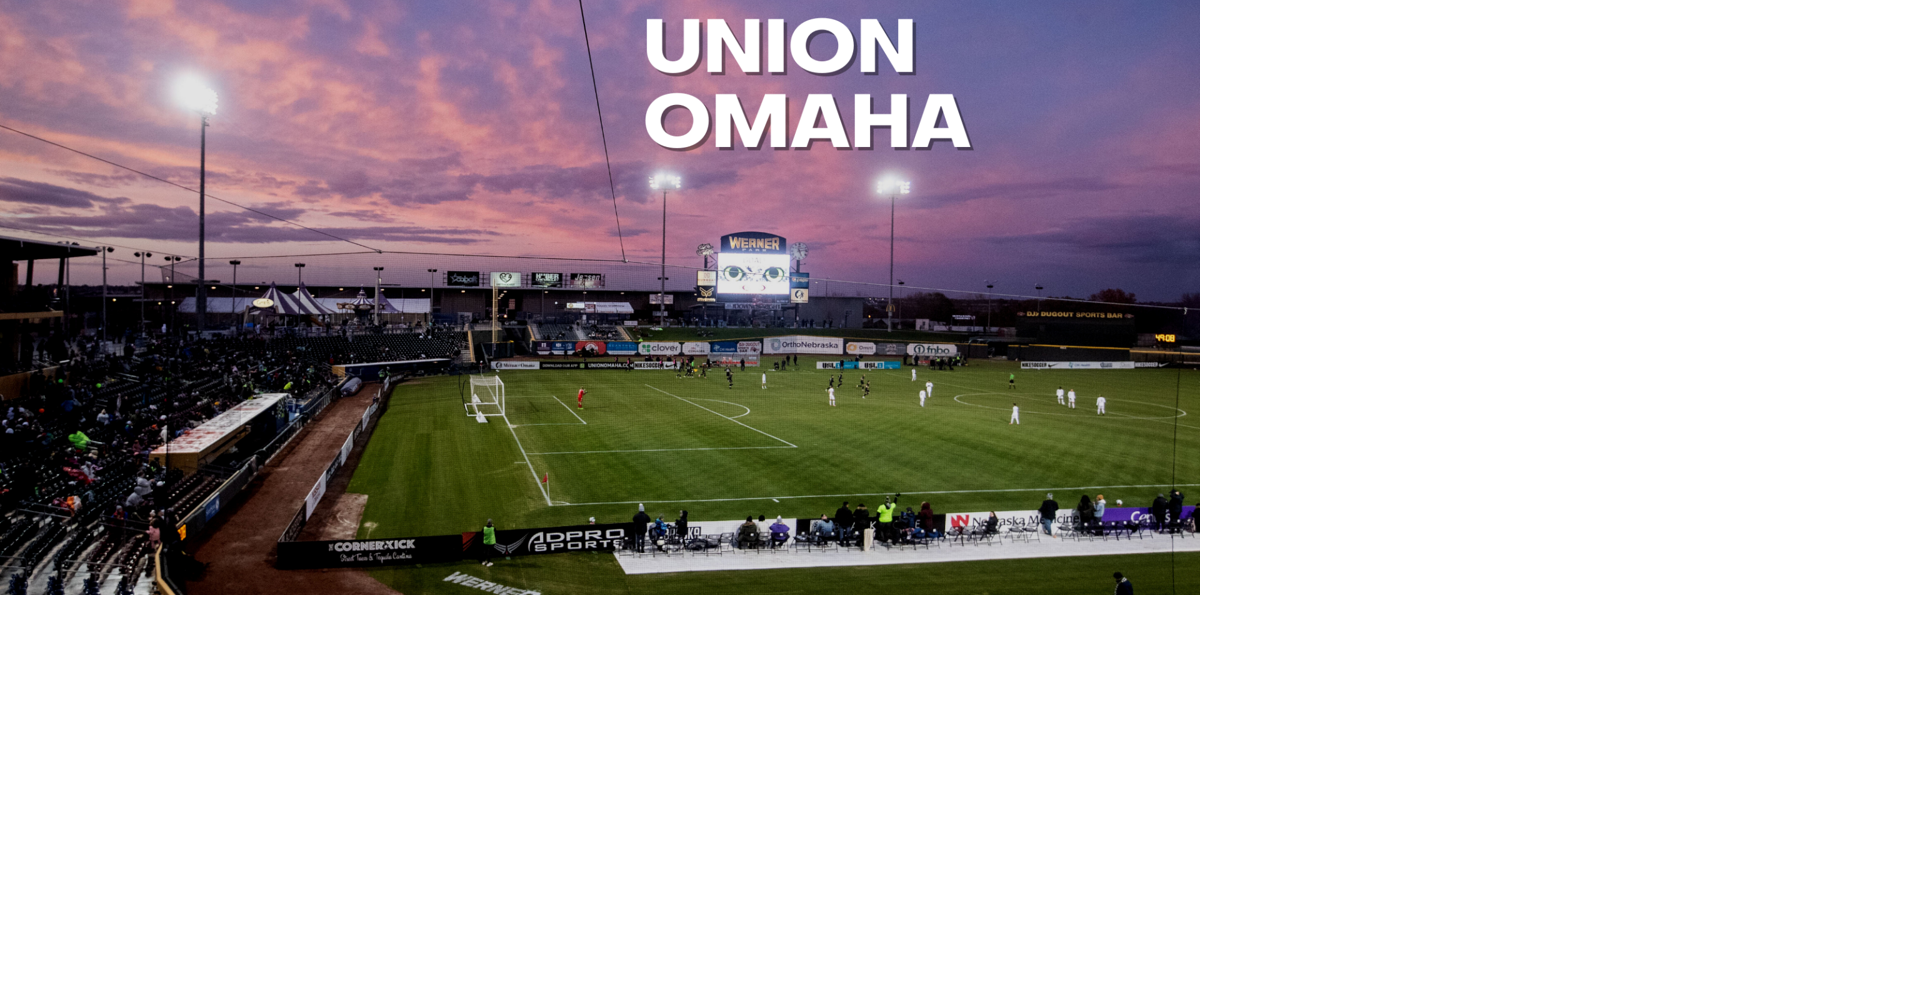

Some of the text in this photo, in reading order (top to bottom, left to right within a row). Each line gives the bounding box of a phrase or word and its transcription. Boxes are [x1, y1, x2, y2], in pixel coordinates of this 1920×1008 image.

[729, 236, 780, 250] WERNER
[575, 273, 600, 281] Jesen
[1155, 333, 1176, 343] 49:08
[652, 343, 678, 352] clover
[782, 341, 838, 349] OrthoNebraska
[927, 345, 950, 354] fnbo
[973, 514, 1081, 526] Neaska Meicine
[1131, 509, 1171, 523] Cens
[528, 528, 625, 552] ADPRO
[535, 539, 624, 552] SPORTS
[334, 541, 385, 552] CORNER
[374, 551, 392, 564] Tequila
[392, 550, 412, 560] Cantina
